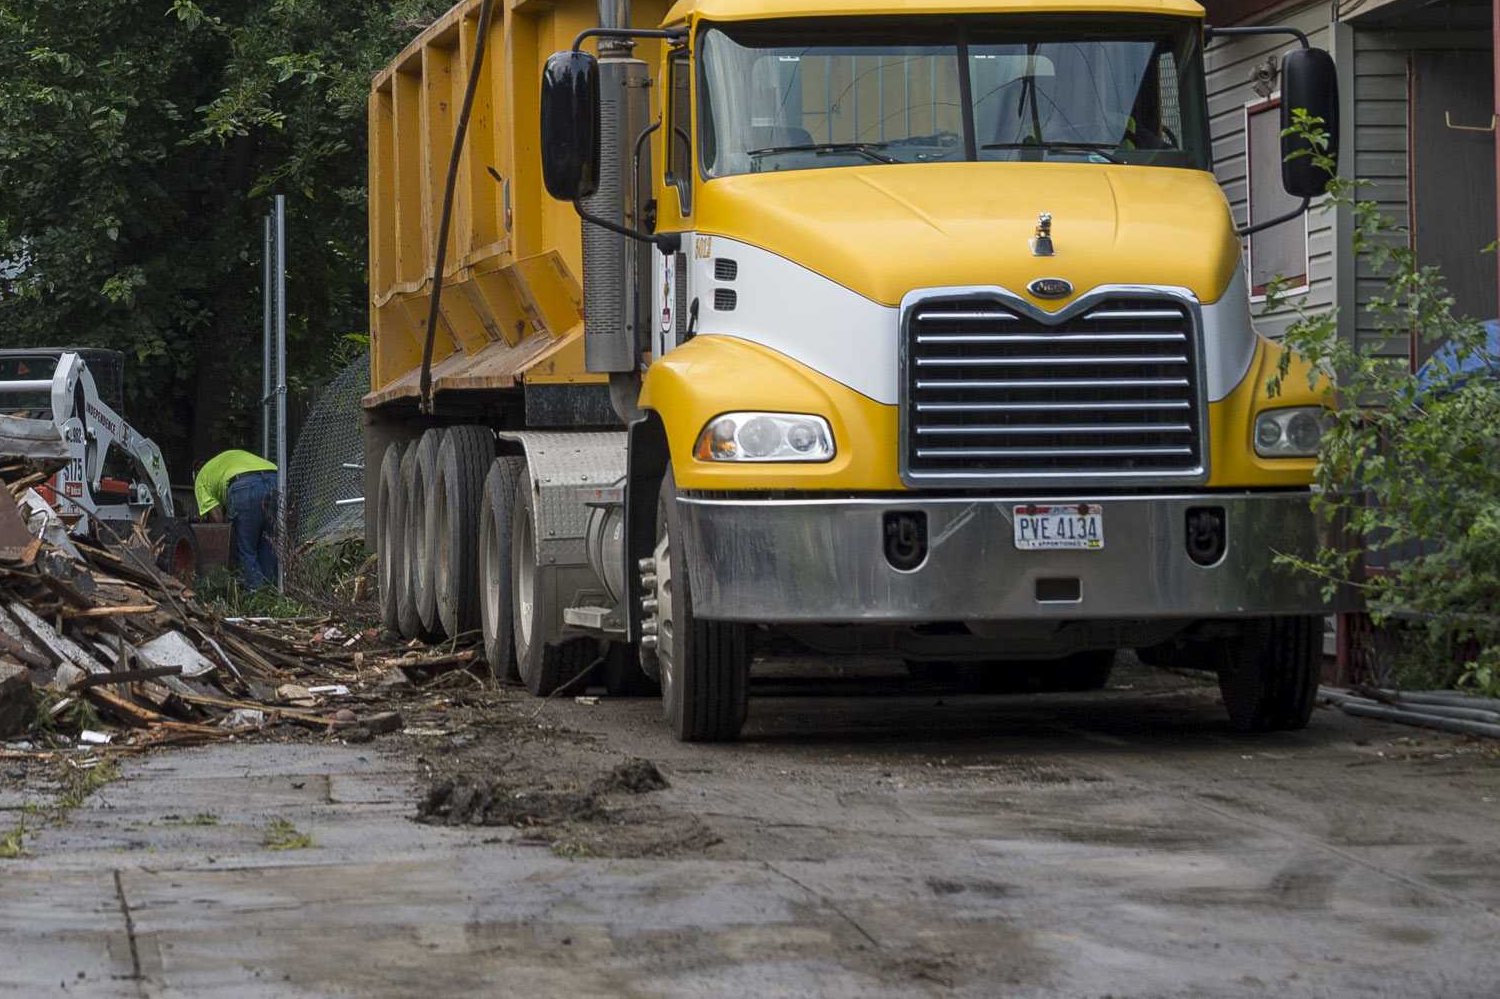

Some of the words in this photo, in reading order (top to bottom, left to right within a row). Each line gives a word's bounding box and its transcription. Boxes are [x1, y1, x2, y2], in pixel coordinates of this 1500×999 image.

[86, 402, 116, 435] INDEPENDENCE
[1019, 517, 1050, 539] PVE
[1056, 517, 1097, 539] 4134
